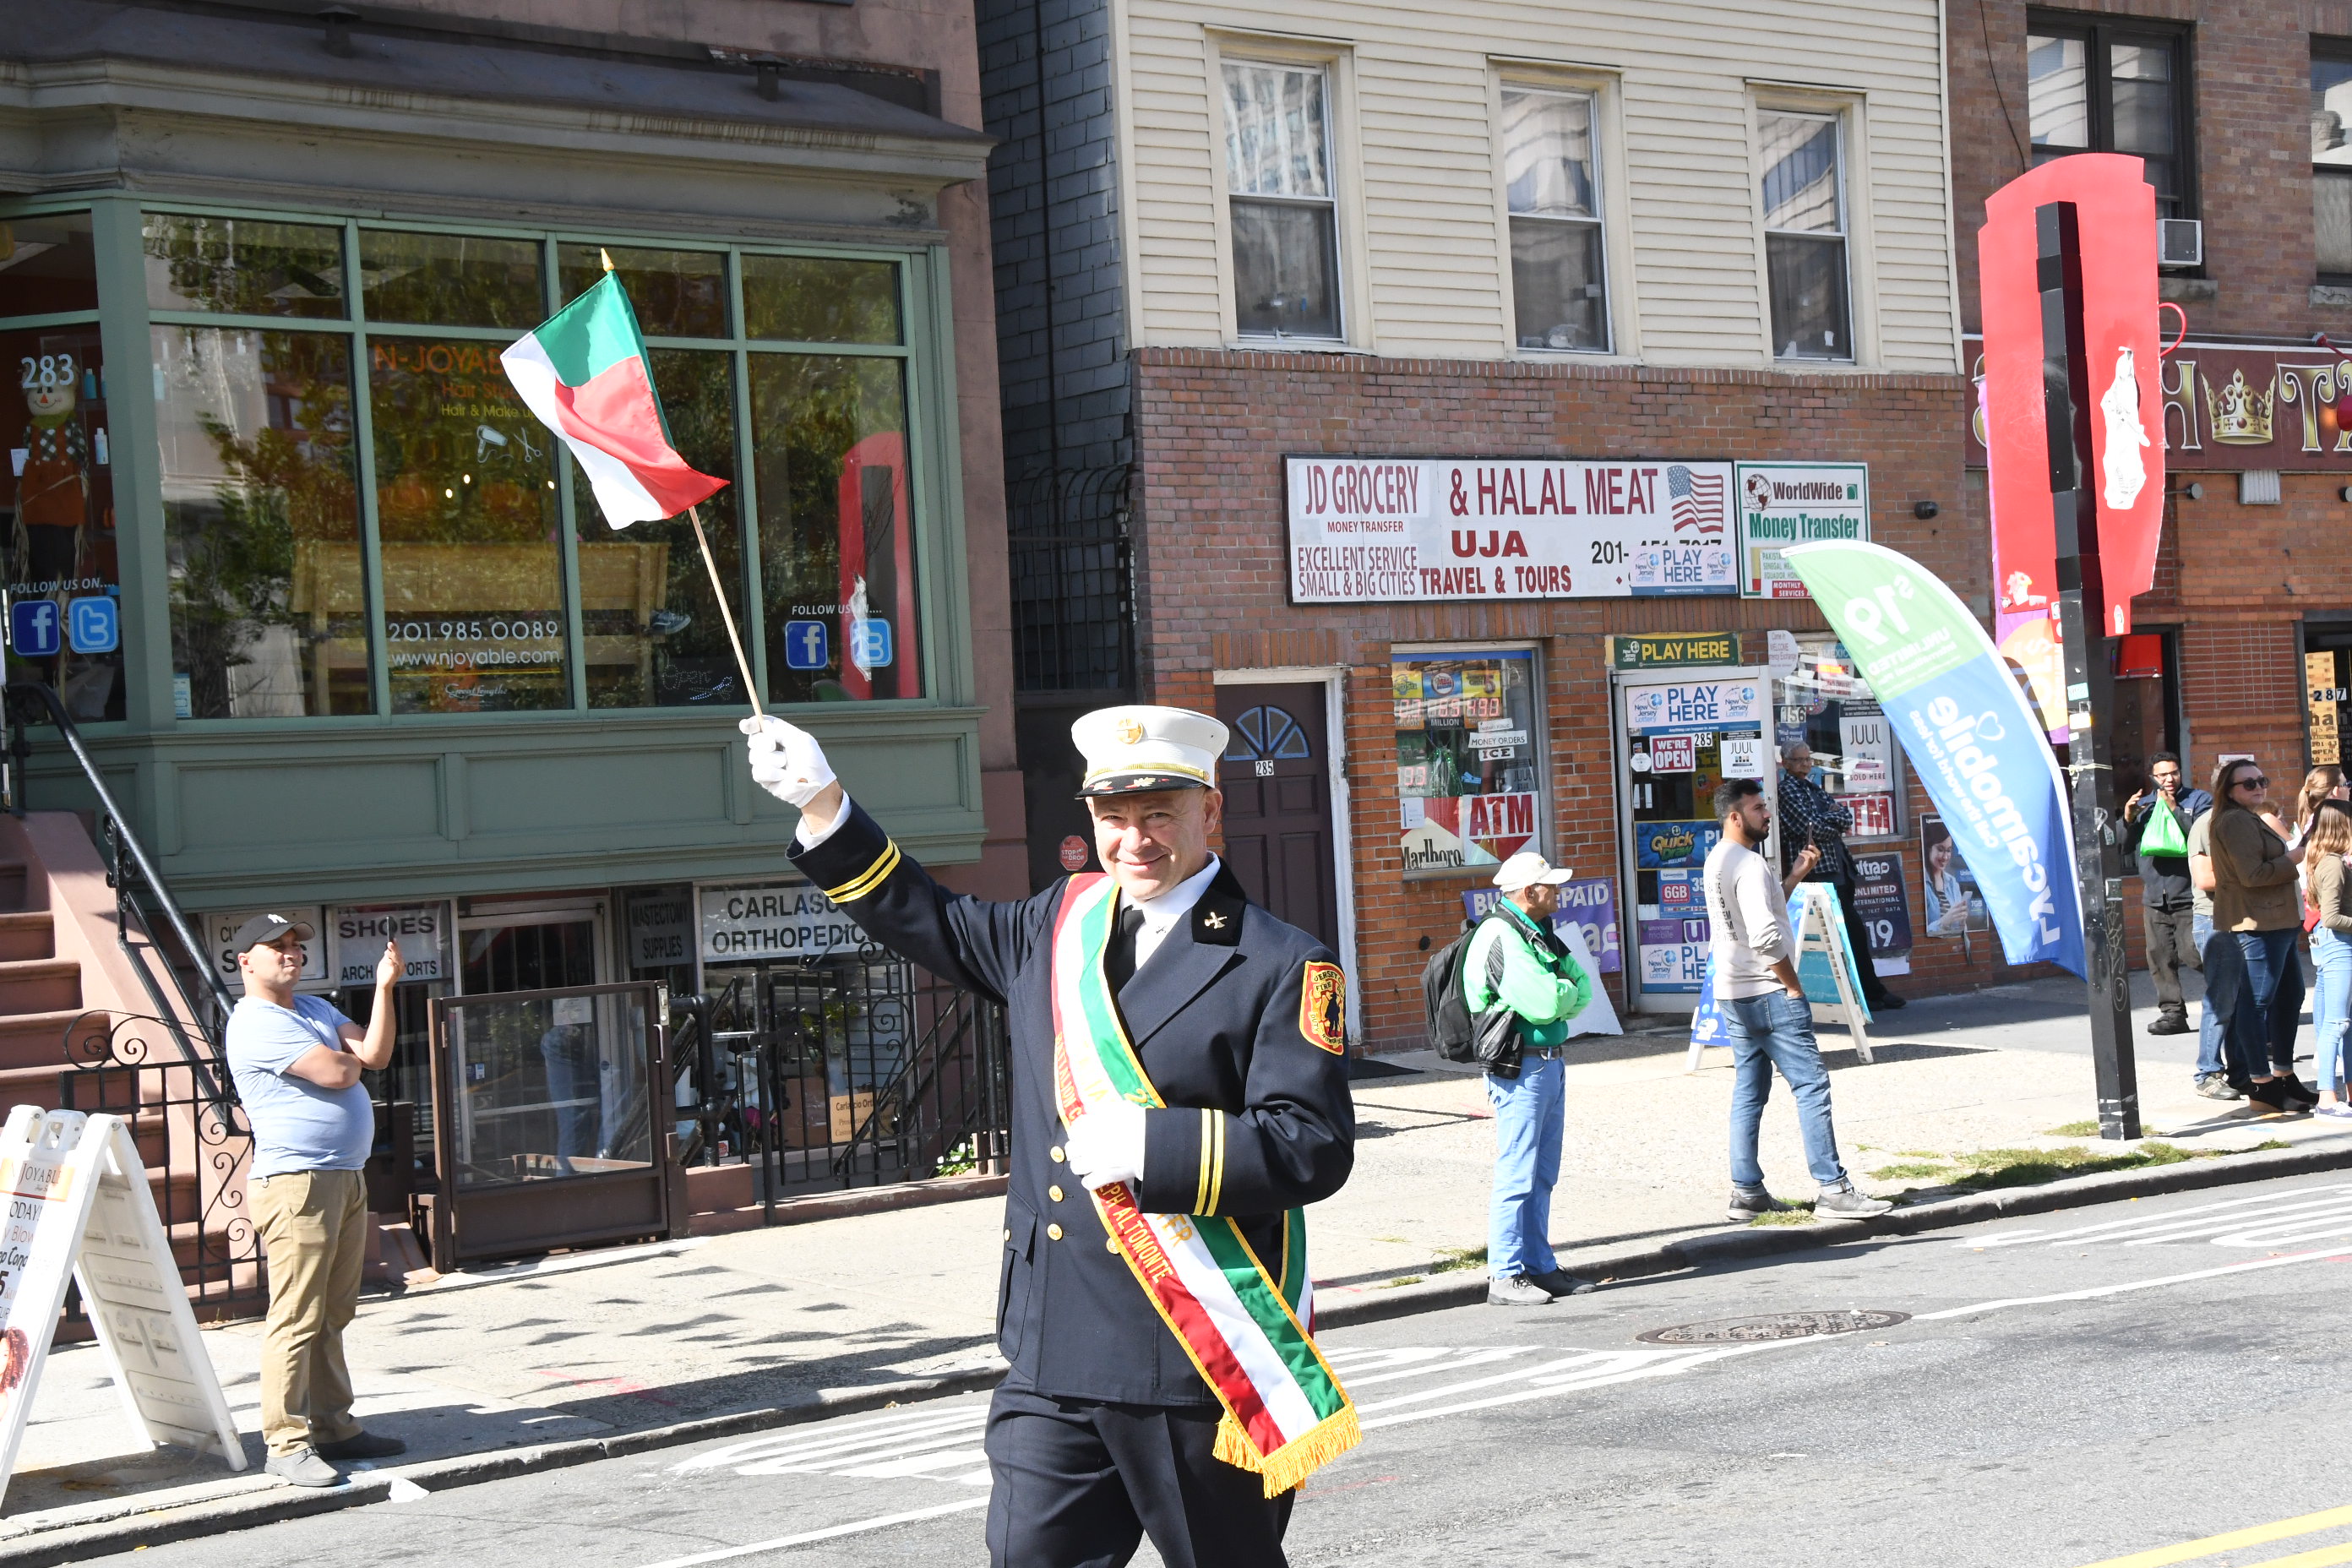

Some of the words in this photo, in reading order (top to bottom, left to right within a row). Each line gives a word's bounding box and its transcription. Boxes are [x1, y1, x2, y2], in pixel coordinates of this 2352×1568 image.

[373, 344, 504, 374] N-JOYAB
[21, 353, 75, 389] 283
[442, 405, 466, 416] Hair
[471, 406, 480, 416] &
[484, 406, 519, 417] Make
[1306, 466, 1327, 514] JD
[1332, 466, 1419, 514] GROCERY
[1450, 468, 1469, 516] &
[1478, 468, 1576, 515] HALAL
[1585, 468, 1658, 514] MEAT
[1772, 482, 1843, 500] WorldWide
[1327, 521, 1358, 532] MONEY
[1360, 521, 1404, 532] TRANSFER
[1749, 513, 1797, 542] Money
[1799, 513, 1859, 539] Transfer
[1451, 531, 1528, 558] UJA
[1298, 547, 1365, 572] EXCELLENT
[1368, 546, 1418, 571] SERVICE
[1663, 549, 1702, 565] PLAY
[1419, 567, 1486, 595] TRAVEL
[1494, 566, 1506, 594] &
[1515, 565, 1571, 593] TOURS
[1663, 566, 1702, 582] HERE
[10, 580, 58, 594] FOLLOW
[63, 579, 78, 591] US
[1298, 572, 1341, 597] SMALL
[1343, 572, 1353, 596] &
[1356, 571, 1376, 596] BIG
[1379, 571, 1416, 596] CITIES
[792, 605, 836, 615] FOLLOW
[838, 604, 851, 614] US
[391, 648, 561, 669] www.njoyable.com
[1642, 642, 1684, 661] PLAY
[1687, 641, 1730, 659] HERE
[1668, 685, 1718, 705] PLAY
[2313, 688, 2345, 702] 287
[1669, 703, 1719, 721] HERE
[1430, 718, 1461, 727] MILLION
[1471, 738, 1497, 746] MONEY
[1498, 736, 1526, 744] ORDERS
[1694, 732, 1712, 747] 285
[1850, 724, 1881, 745] JUUL
[1482, 748, 1511, 760] ICE
[1656, 739, 1688, 750] WE'RE
[1730, 742, 1754, 754] JUUL
[1256, 760, 1273, 776] 285
[1654, 749, 1690, 769] OPEN
[1469, 794, 1534, 836] ATM
[1652, 830, 1695, 855] Quick
[1663, 885, 1688, 899] 6GB
[712, 924, 878, 954] ORTHOPEDIC
[1865, 919, 1894, 948] 19
[643, 935, 683, 959] SUPPLIES
[341, 966, 373, 981] ARCH
[1314, 970, 1338, 982] JERSEY
[1315, 981, 1332, 992] FIRE
[1112, 1207, 1174, 1283] ALTOMONTE
